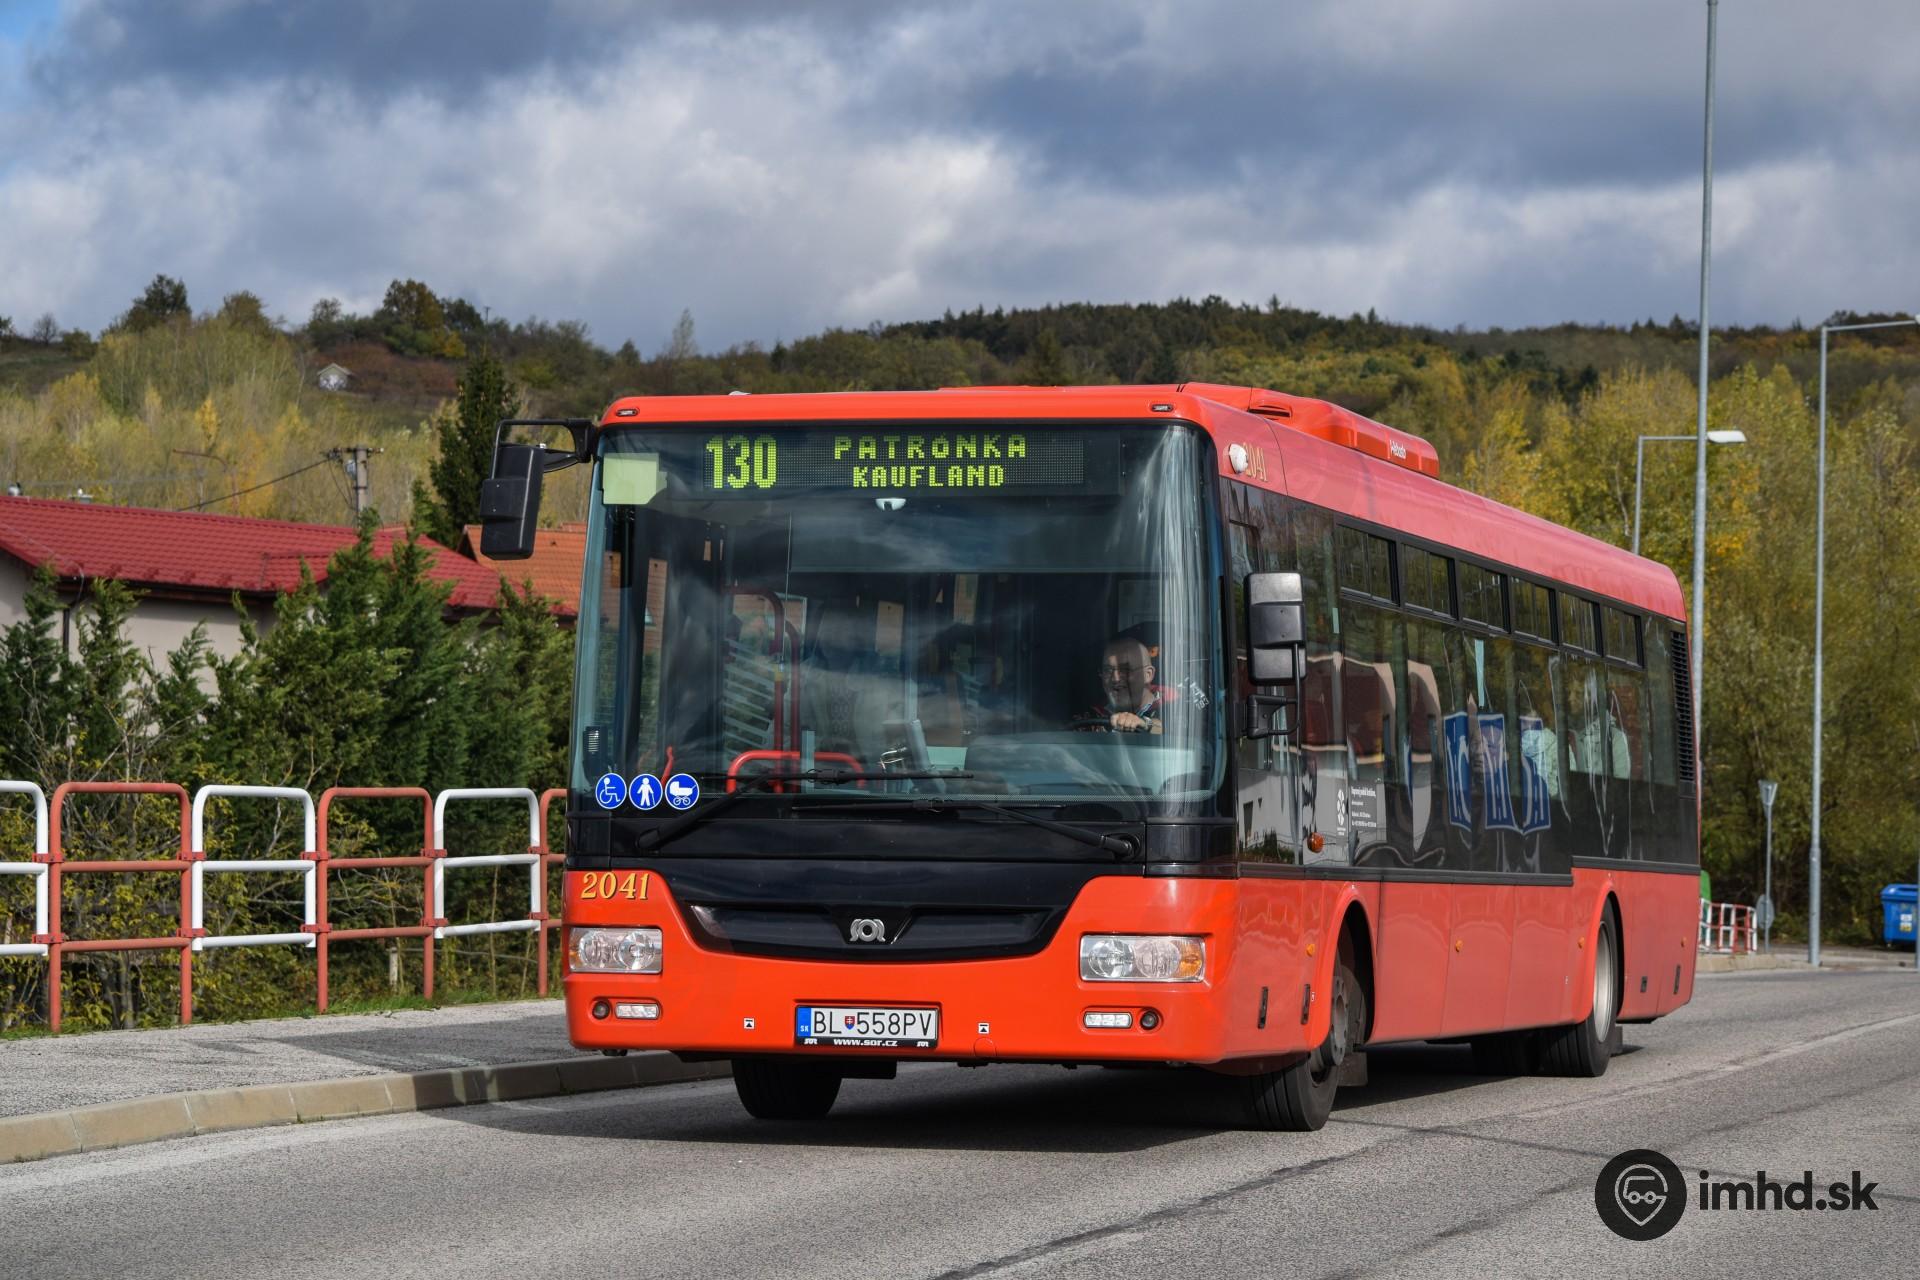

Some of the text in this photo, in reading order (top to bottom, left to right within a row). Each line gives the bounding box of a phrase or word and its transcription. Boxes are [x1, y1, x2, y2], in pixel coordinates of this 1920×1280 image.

[706, 435, 777, 488] 130
[853, 465, 1004, 488] KAUFLAND
[581, 871, 649, 900] 2041
[813, 1011, 932, 1036] BL 558PV
[834, 1038, 898, 1047] www.sor.cz
